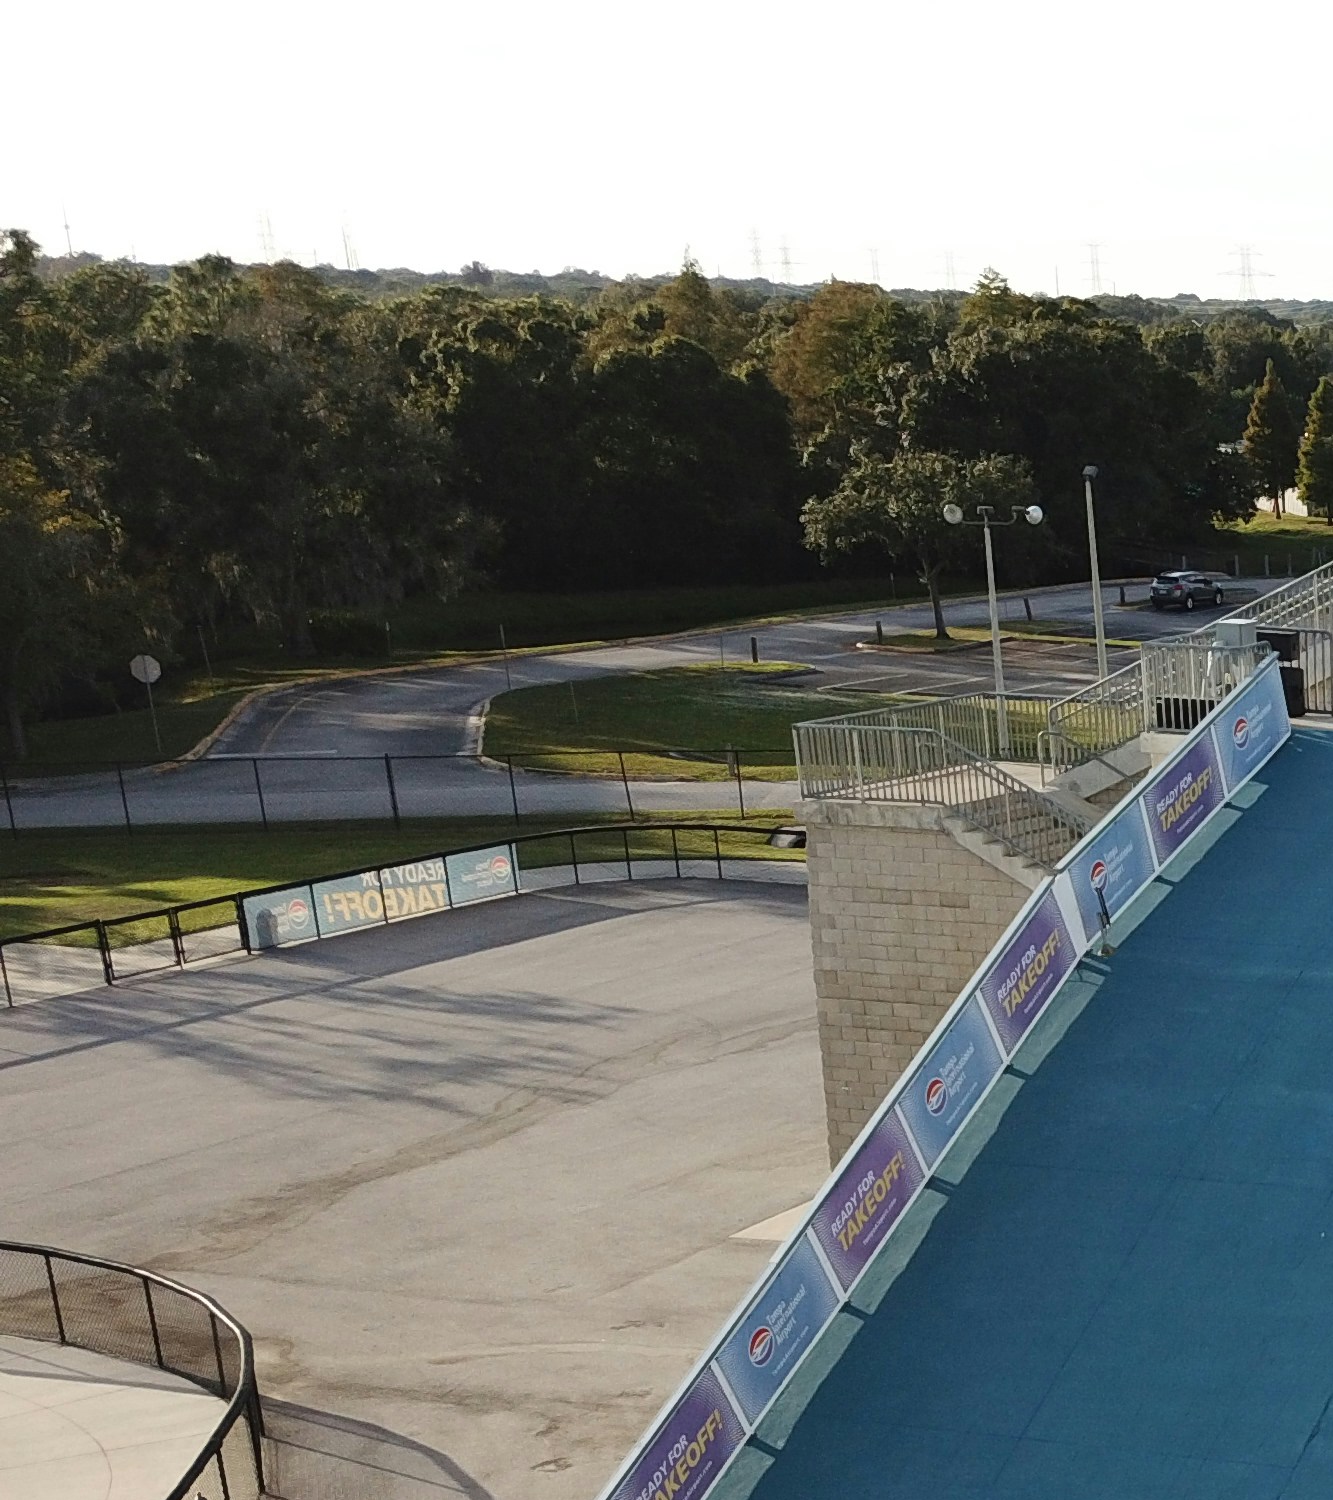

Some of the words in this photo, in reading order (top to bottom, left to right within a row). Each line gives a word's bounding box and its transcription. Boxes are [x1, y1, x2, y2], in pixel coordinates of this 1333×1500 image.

[997, 963, 1021, 1004] READY
[1021, 944, 1037, 970] FOR
[1002, 927, 1061, 1018] TAKEOFF!
[830, 1192, 858, 1238] READY
[857, 1170, 876, 1199] FOR
[837, 1150, 906, 1252] TAKEOFF!
[667, 1434, 689, 1467] FOR
